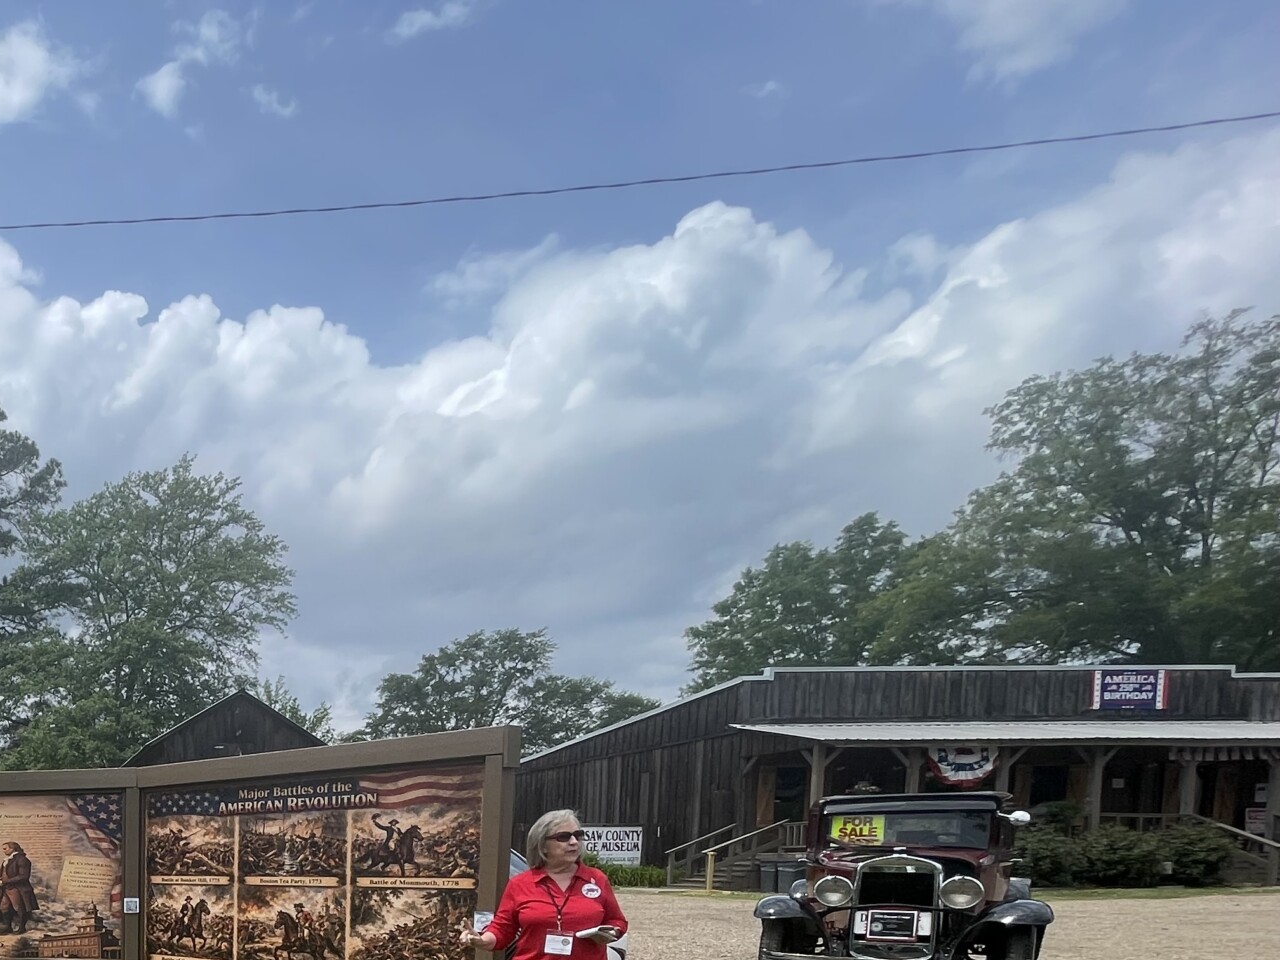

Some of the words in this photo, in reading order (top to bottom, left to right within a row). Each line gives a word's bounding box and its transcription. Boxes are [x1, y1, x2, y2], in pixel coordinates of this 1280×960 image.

[1104, 675, 1155, 684] AMERICA
[1103, 691, 1154, 700] BIRTHDAY
[238, 788, 270, 800] Major
[273, 784, 313, 797] Battles
[317, 783, 330, 794] of
[332, 781, 352, 792] the
[218, 799, 283, 816] AMERICAN
[287, 793, 377, 811] REVOLUTION
[842, 816, 874, 827] FOR
[605, 830, 643, 842] COUNTY
[838, 826, 878, 839] SALE
[600, 841, 640, 852] MUSEUM
